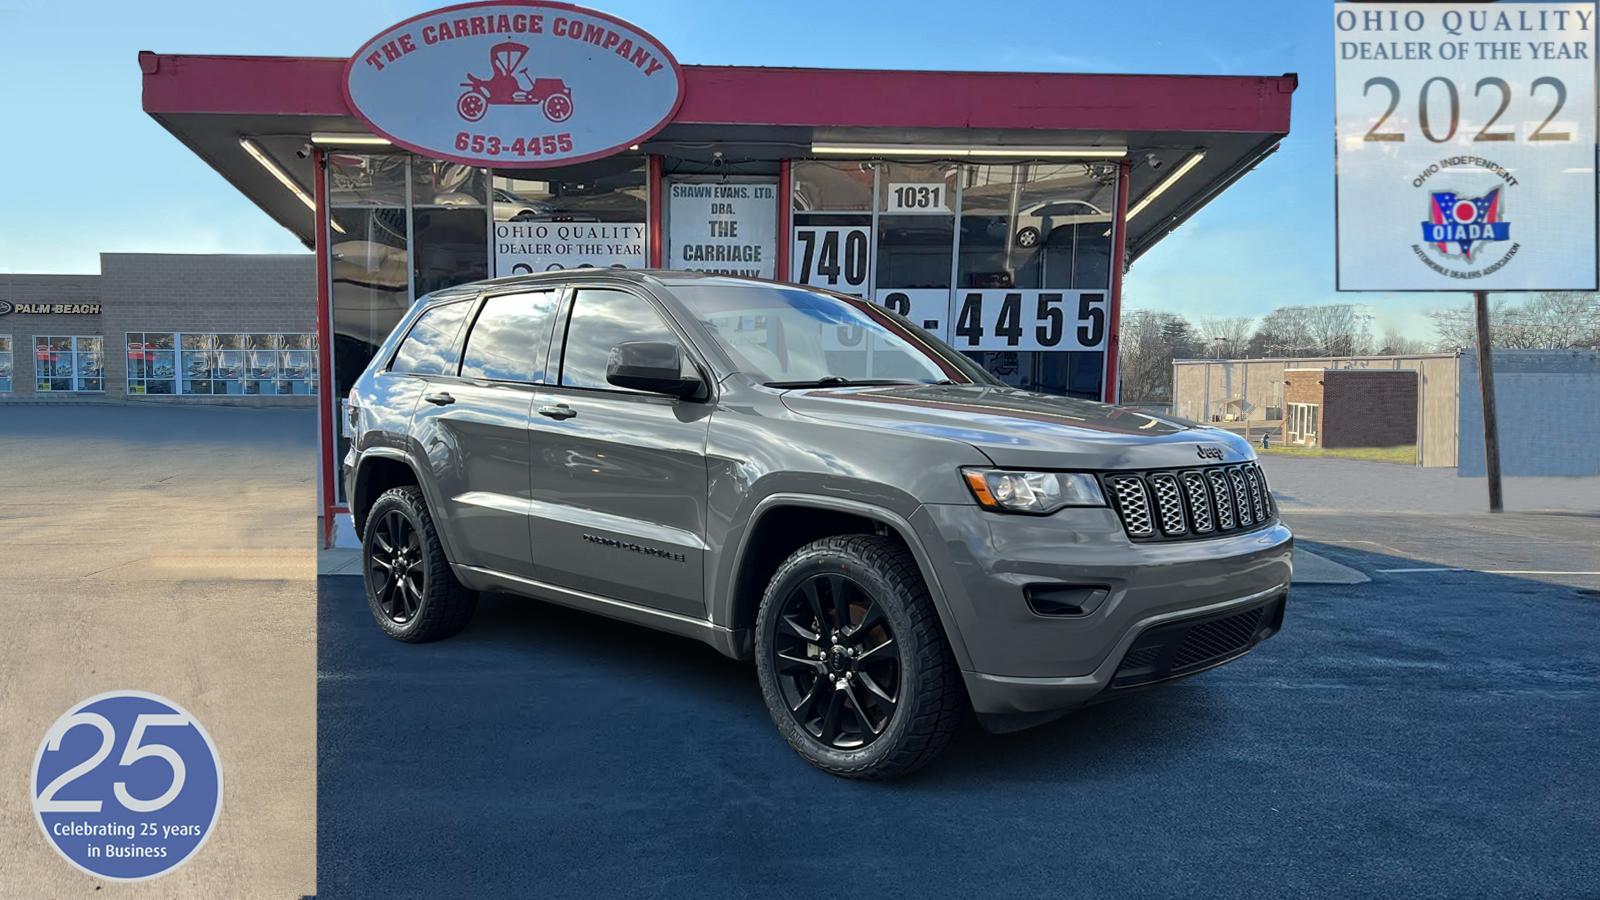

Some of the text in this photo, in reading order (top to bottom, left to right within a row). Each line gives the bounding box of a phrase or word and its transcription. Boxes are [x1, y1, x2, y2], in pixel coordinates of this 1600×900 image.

[1336, 10, 1593, 36] OHIO QUALITY
[365, 14, 664, 77] THE CARRIAGE COMPANY
[1340, 42, 1589, 60] DEALER OF THE YEAR
[1363, 76, 1571, 143] 2022
[454, 132, 573, 157] 653-4455
[1412, 155, 1519, 188] OHIO INDEPENDENT
[672, 185, 712, 198] SHAWN
[754, 187, 775, 200] LTD.
[894, 186, 941, 208] 1031
[711, 203, 736, 215] DBA.
[496, 226, 645, 241] OHIO QUALITY
[708, 220, 738, 238] THE
[1432, 224, 1495, 241] OIADA
[499, 243, 642, 255] DEALER OF THE YEAR
[682, 244, 762, 263] CARRIAGE
[797, 229, 867, 286] 740
[1410, 242, 1521, 280] AUTOMOBILE DEALERS ASSOCIATION
[14, 303, 51, 314] PALM
[54, 303, 100, 314] BEACH
[1196, 444, 1224, 461] Jeep
